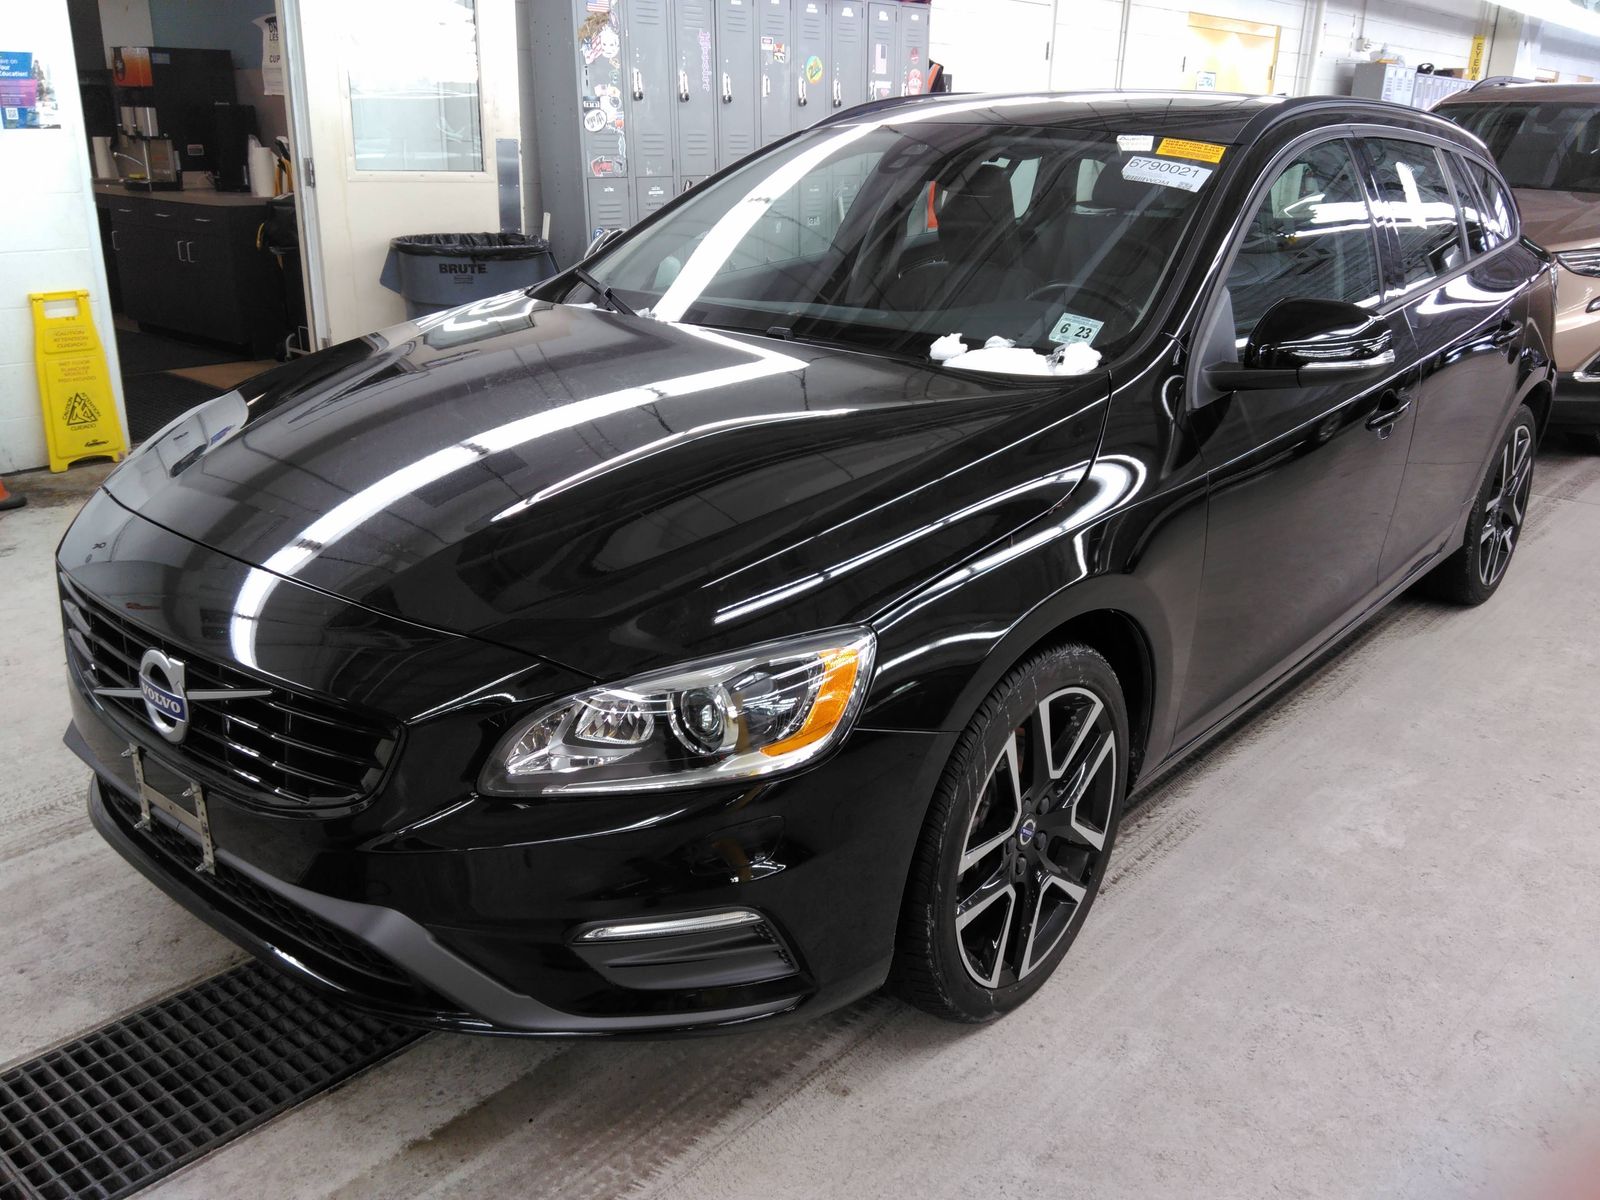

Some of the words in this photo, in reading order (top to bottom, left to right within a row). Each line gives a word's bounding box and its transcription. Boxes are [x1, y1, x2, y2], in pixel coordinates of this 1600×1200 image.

[1129, 158, 1200, 178] 6790021
[439, 263, 487, 274] BRUTE
[1060, 323, 1071, 334] 6
[1074, 326, 1092, 339] 23
[141, 681, 181, 713] VOLVO
